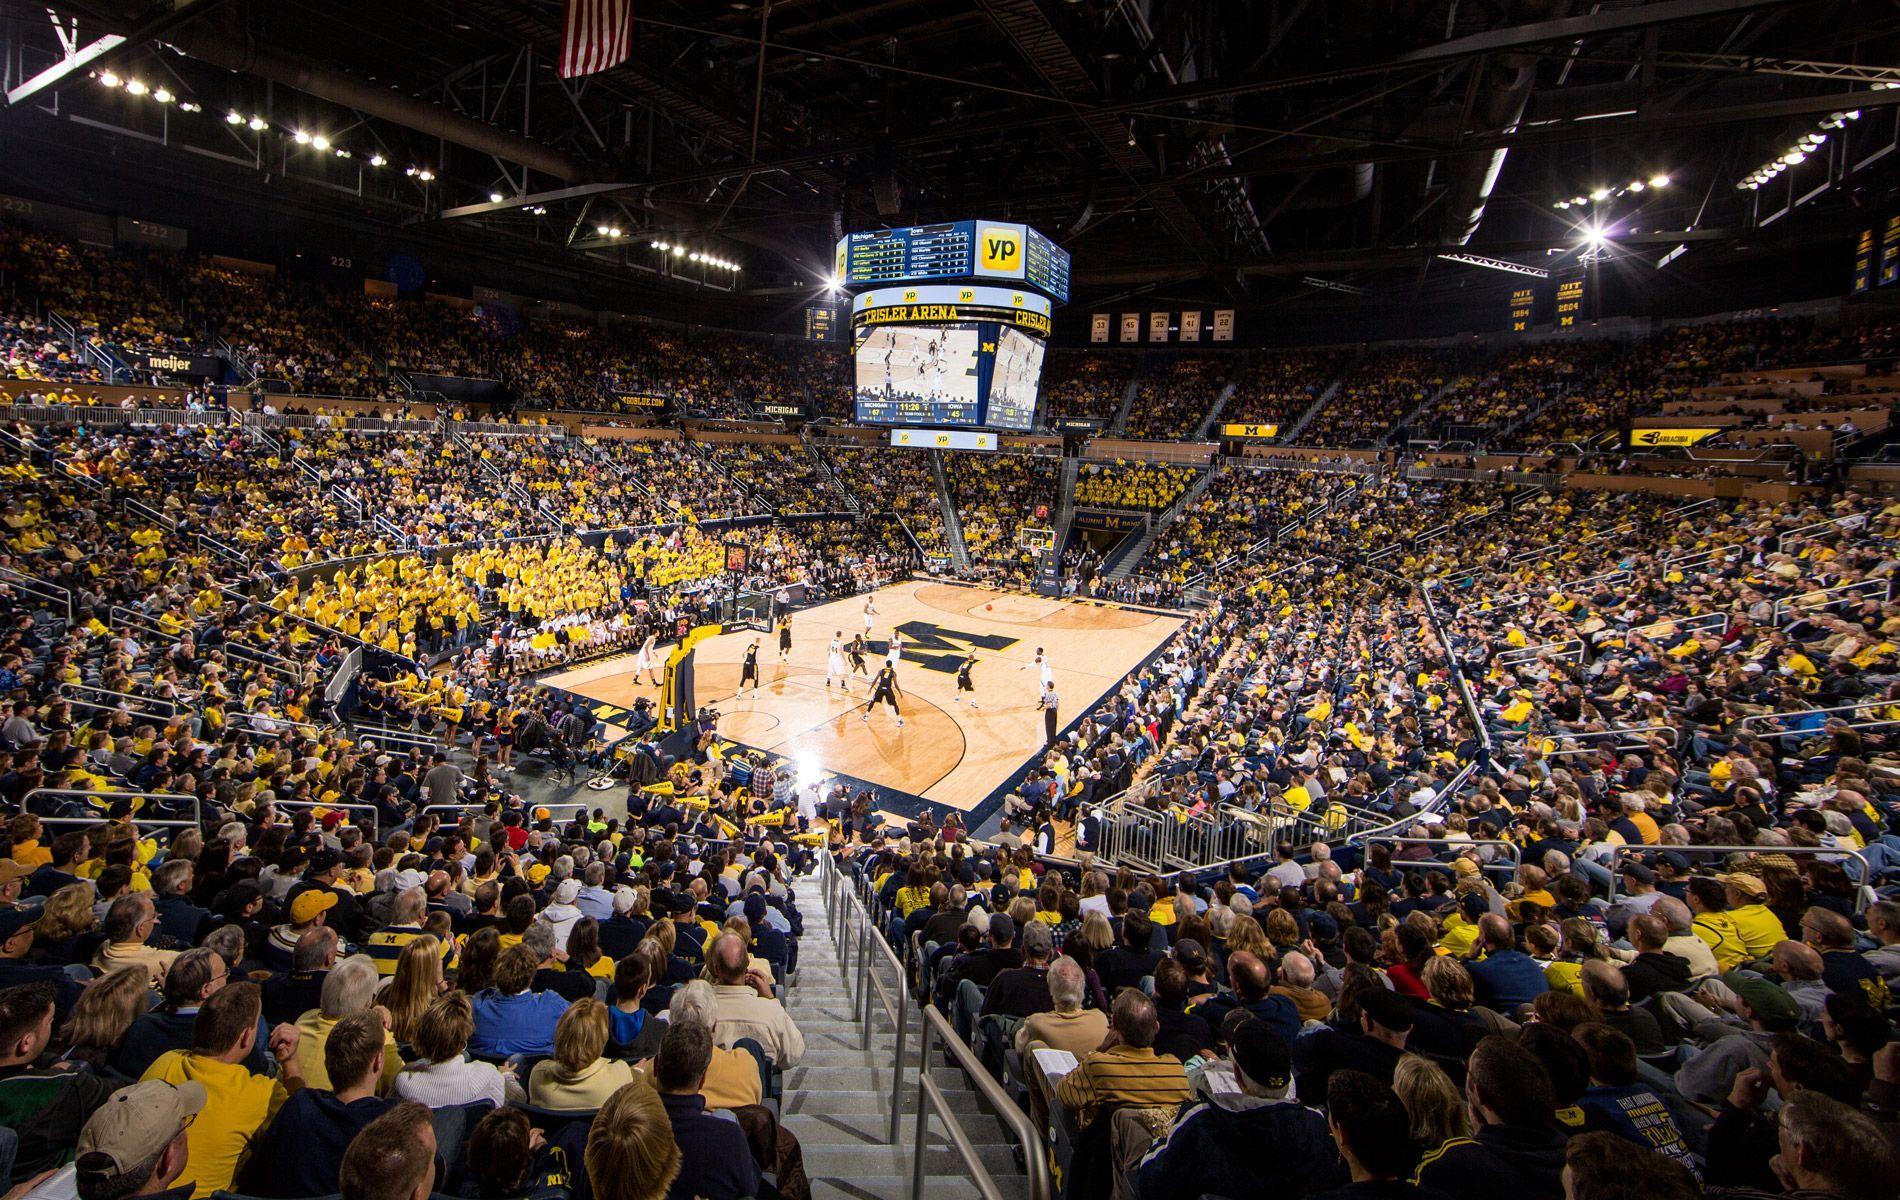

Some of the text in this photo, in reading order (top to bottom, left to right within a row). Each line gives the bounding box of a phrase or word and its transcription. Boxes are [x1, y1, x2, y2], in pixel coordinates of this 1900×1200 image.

[852, 233, 875, 241] Michigan
[988, 239, 1016, 261] yp
[330, 256, 352, 268] 223
[1560, 281, 1582, 291] NIT
[906, 291, 916, 301] yp
[962, 290, 973, 300] yp
[1512, 289, 1533, 298] NIT
[1014, 295, 1023, 304] yp
[865, 305, 959, 324] CRISLER ARENA
[1016, 310, 1046, 330] CRISLER
[1126, 321, 1136, 329] 45
[1155, 320, 1165, 328] 35
[1561, 316, 1574, 326] M
[1514, 322, 1526, 331] M
[982, 342, 995, 353] M
[149, 355, 191, 372] meijer
[764, 405, 799, 415] MICHIGAN
[951, 410, 960, 418] 45
[1245, 426, 1259, 435] M
[1106, 516, 1119, 529] M
[385, 935, 397, 943] M
[1568, 1110, 1577, 1118] M
